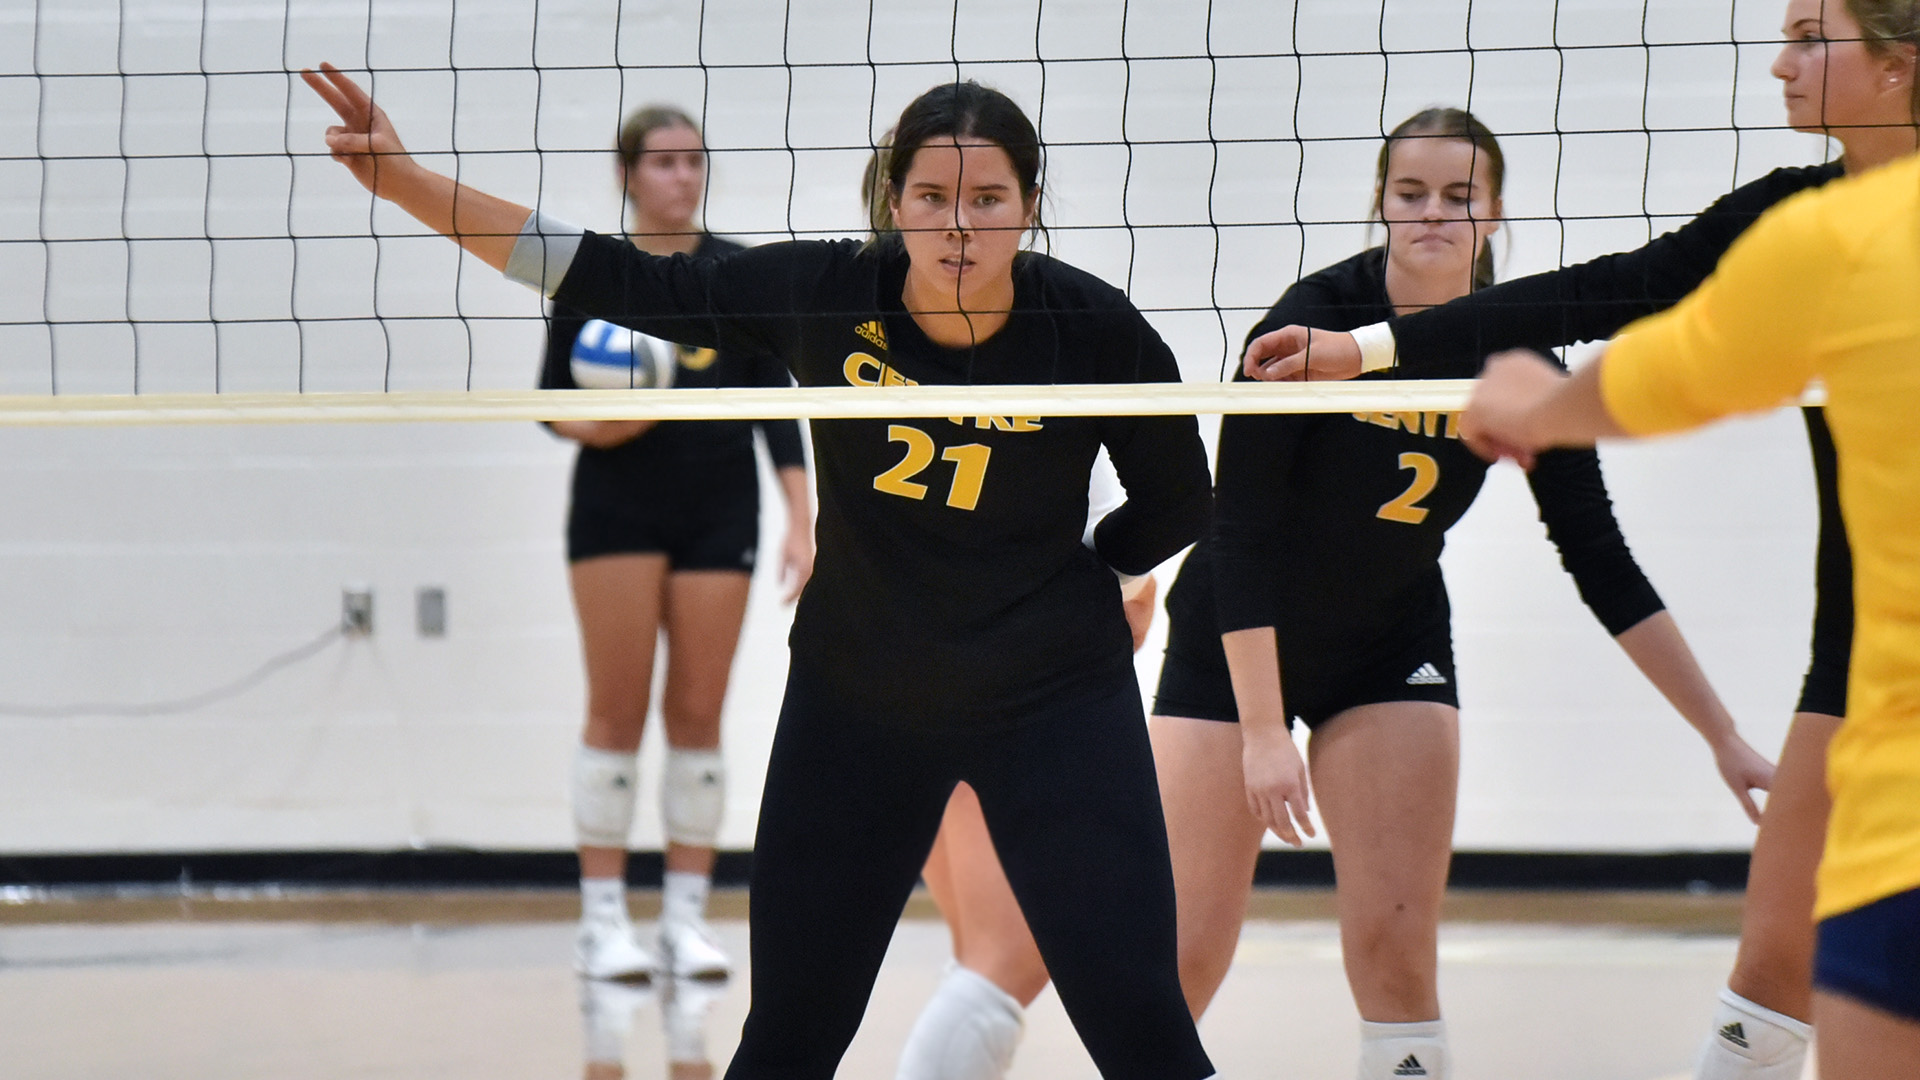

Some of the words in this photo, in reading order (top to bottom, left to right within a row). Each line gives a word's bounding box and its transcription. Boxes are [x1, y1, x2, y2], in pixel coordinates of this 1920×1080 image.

[854, 325, 888, 350] adidas
[873, 424, 992, 511] 21
[1376, 452, 1440, 524] 2
